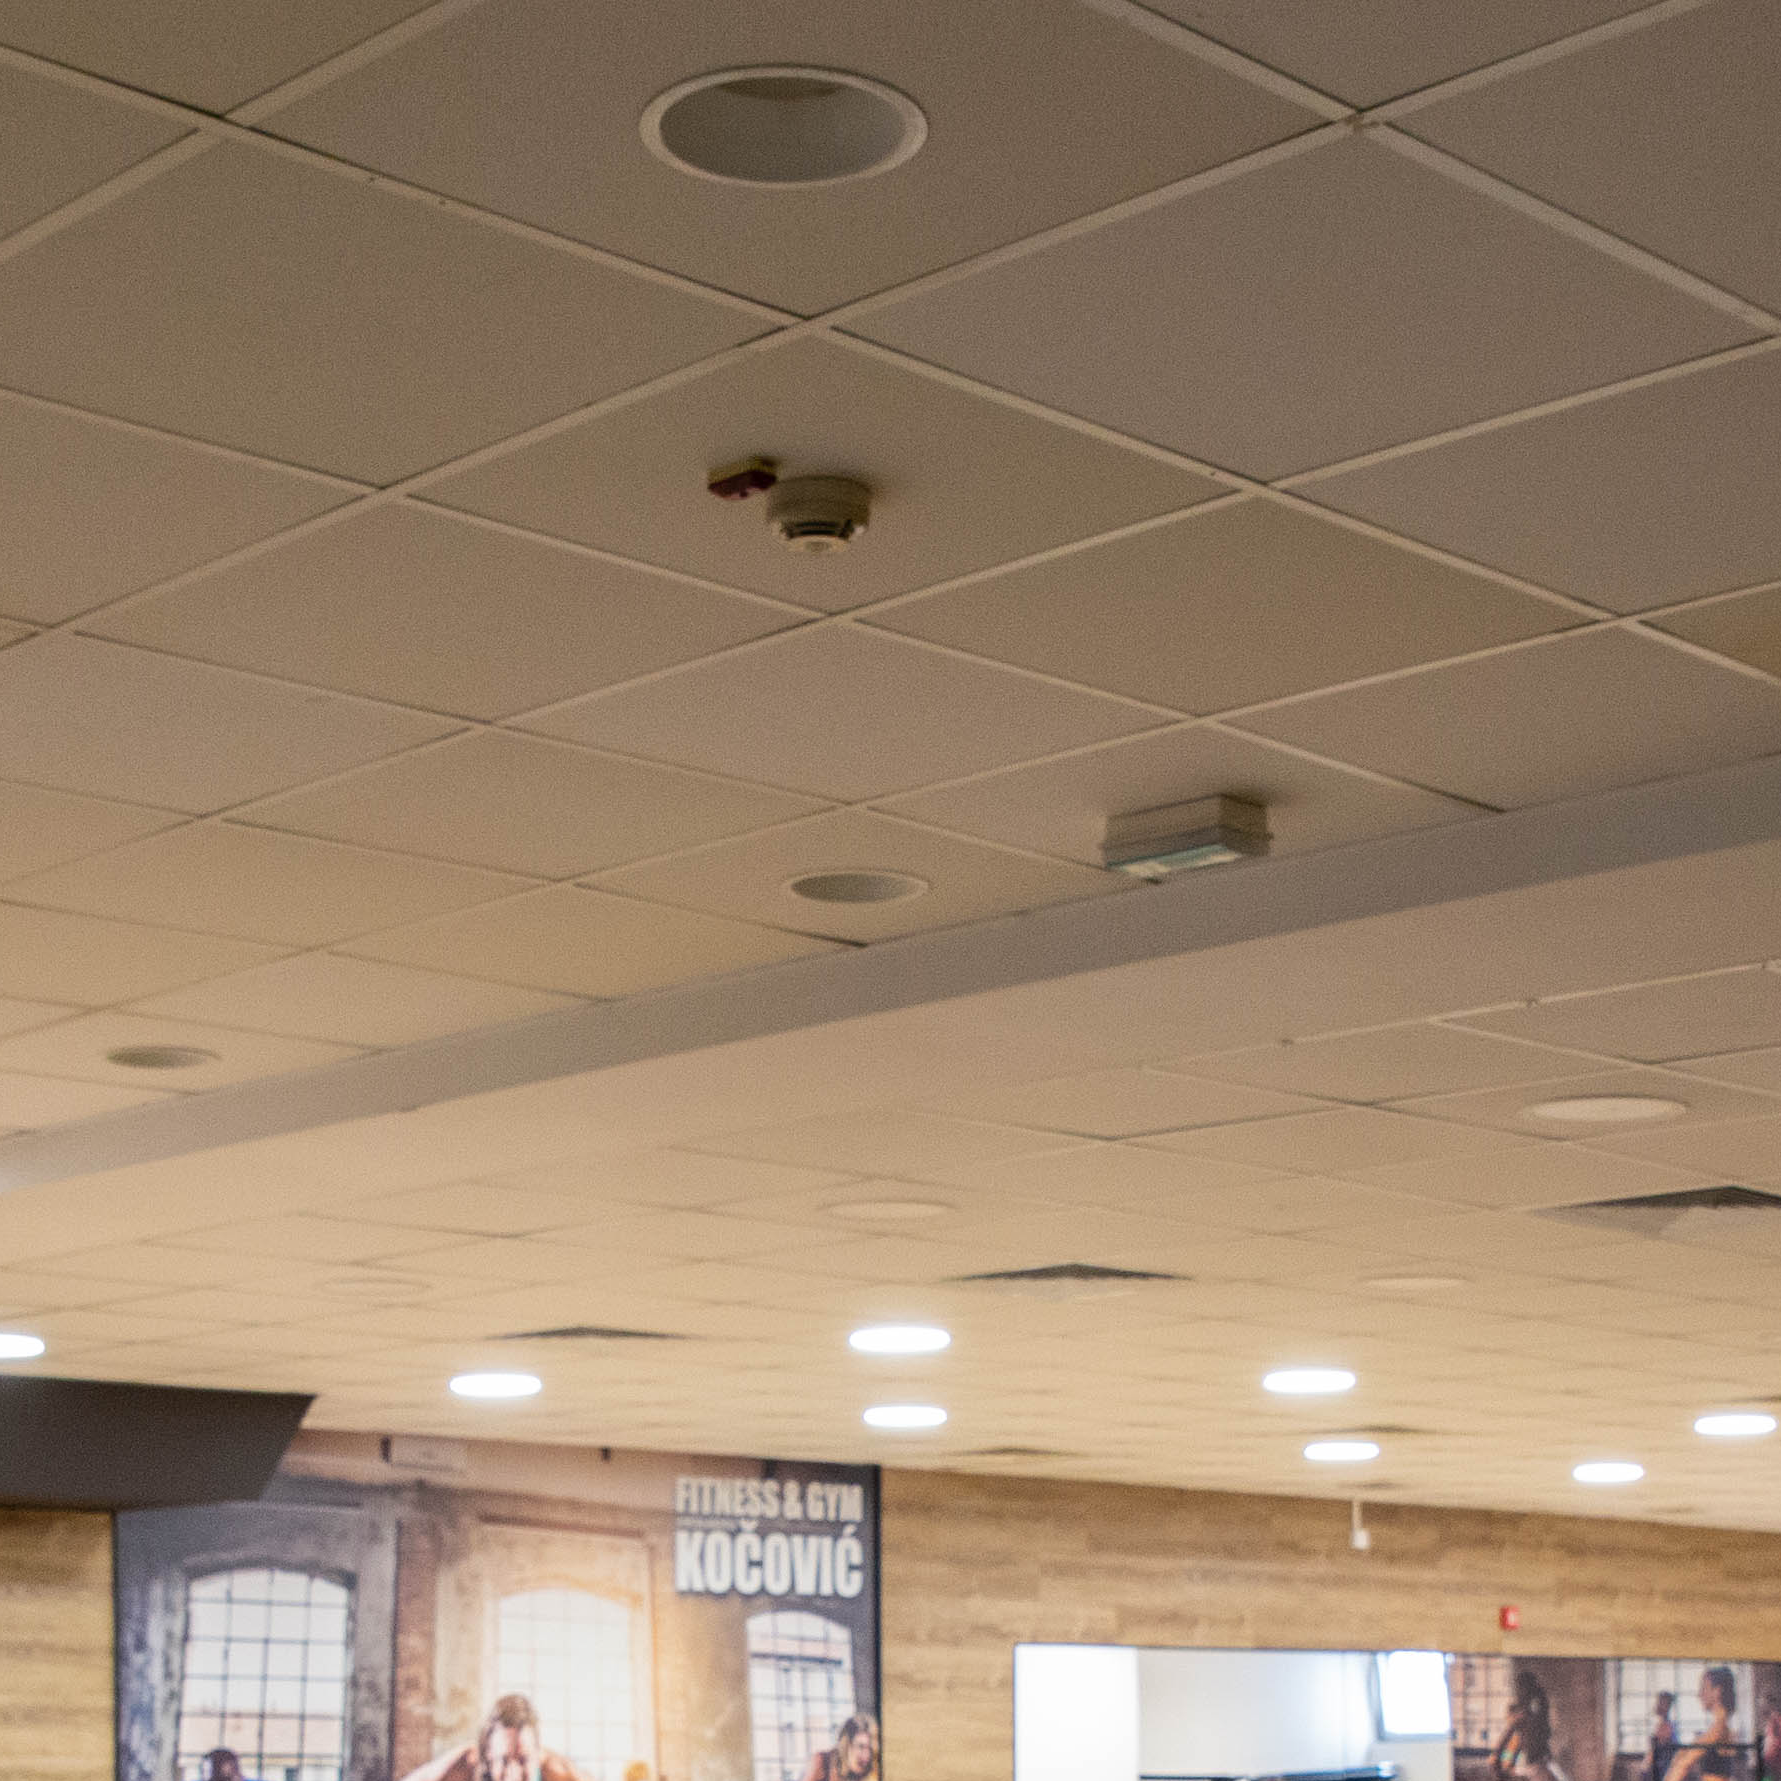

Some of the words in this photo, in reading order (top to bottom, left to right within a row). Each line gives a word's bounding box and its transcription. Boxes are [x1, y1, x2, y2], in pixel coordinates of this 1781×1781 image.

[675, 1476, 781, 1520] FITNESS
[782, 1479, 804, 1521] &
[806, 1481, 865, 1522] GYM
[675, 1518, 865, 1599] KOČOVIĆ
